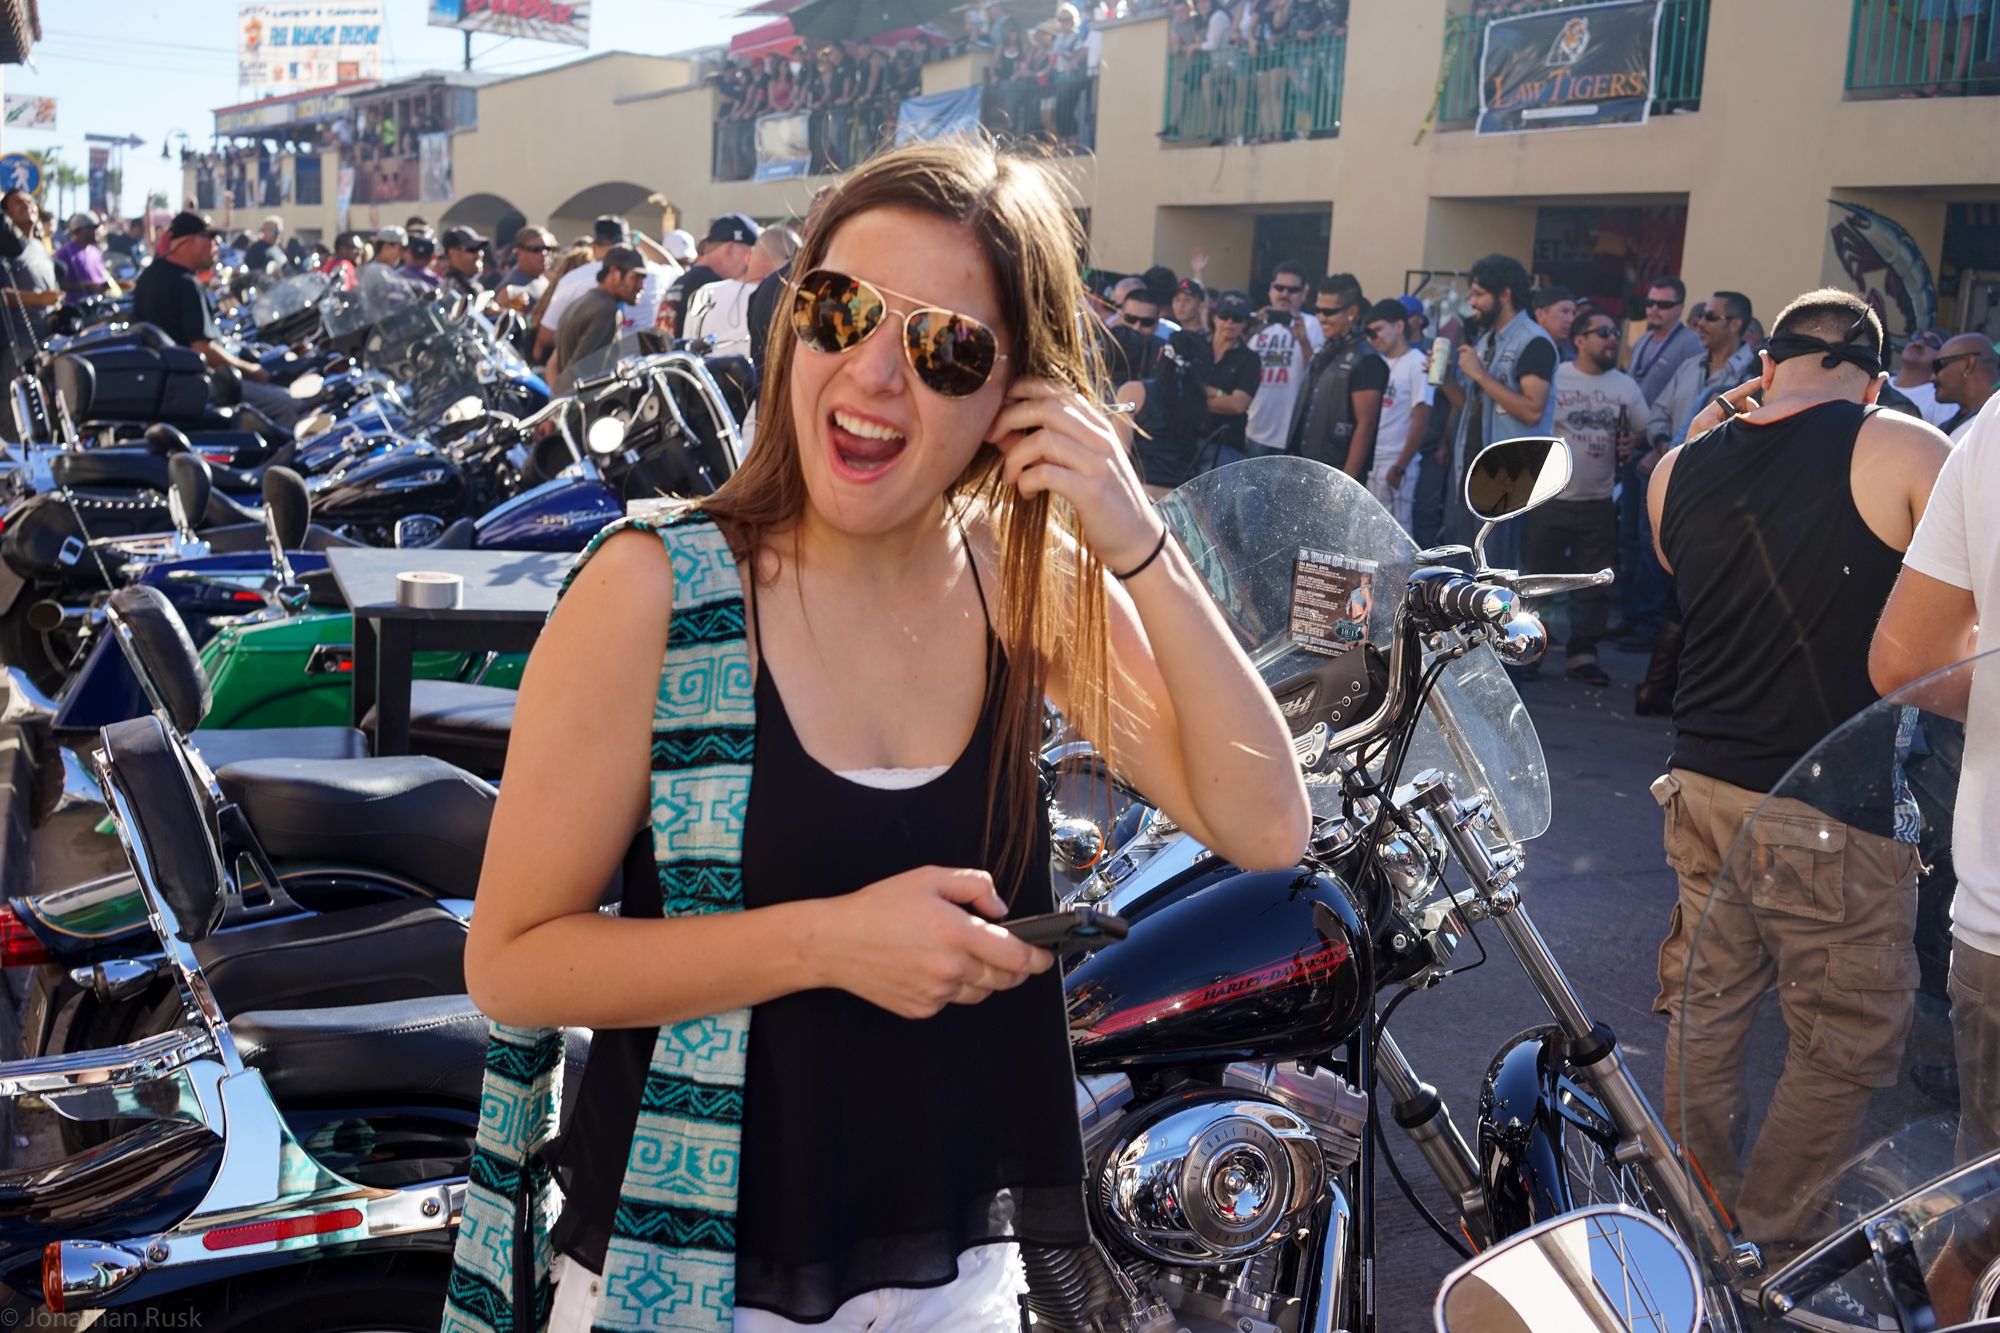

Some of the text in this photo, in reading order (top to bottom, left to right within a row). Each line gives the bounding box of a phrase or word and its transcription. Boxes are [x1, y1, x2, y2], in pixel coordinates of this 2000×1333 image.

[1493, 68, 1644, 109] LAW TIGERS
[1203, 949, 1343, 1001] HARLEY-DAVIDSON
